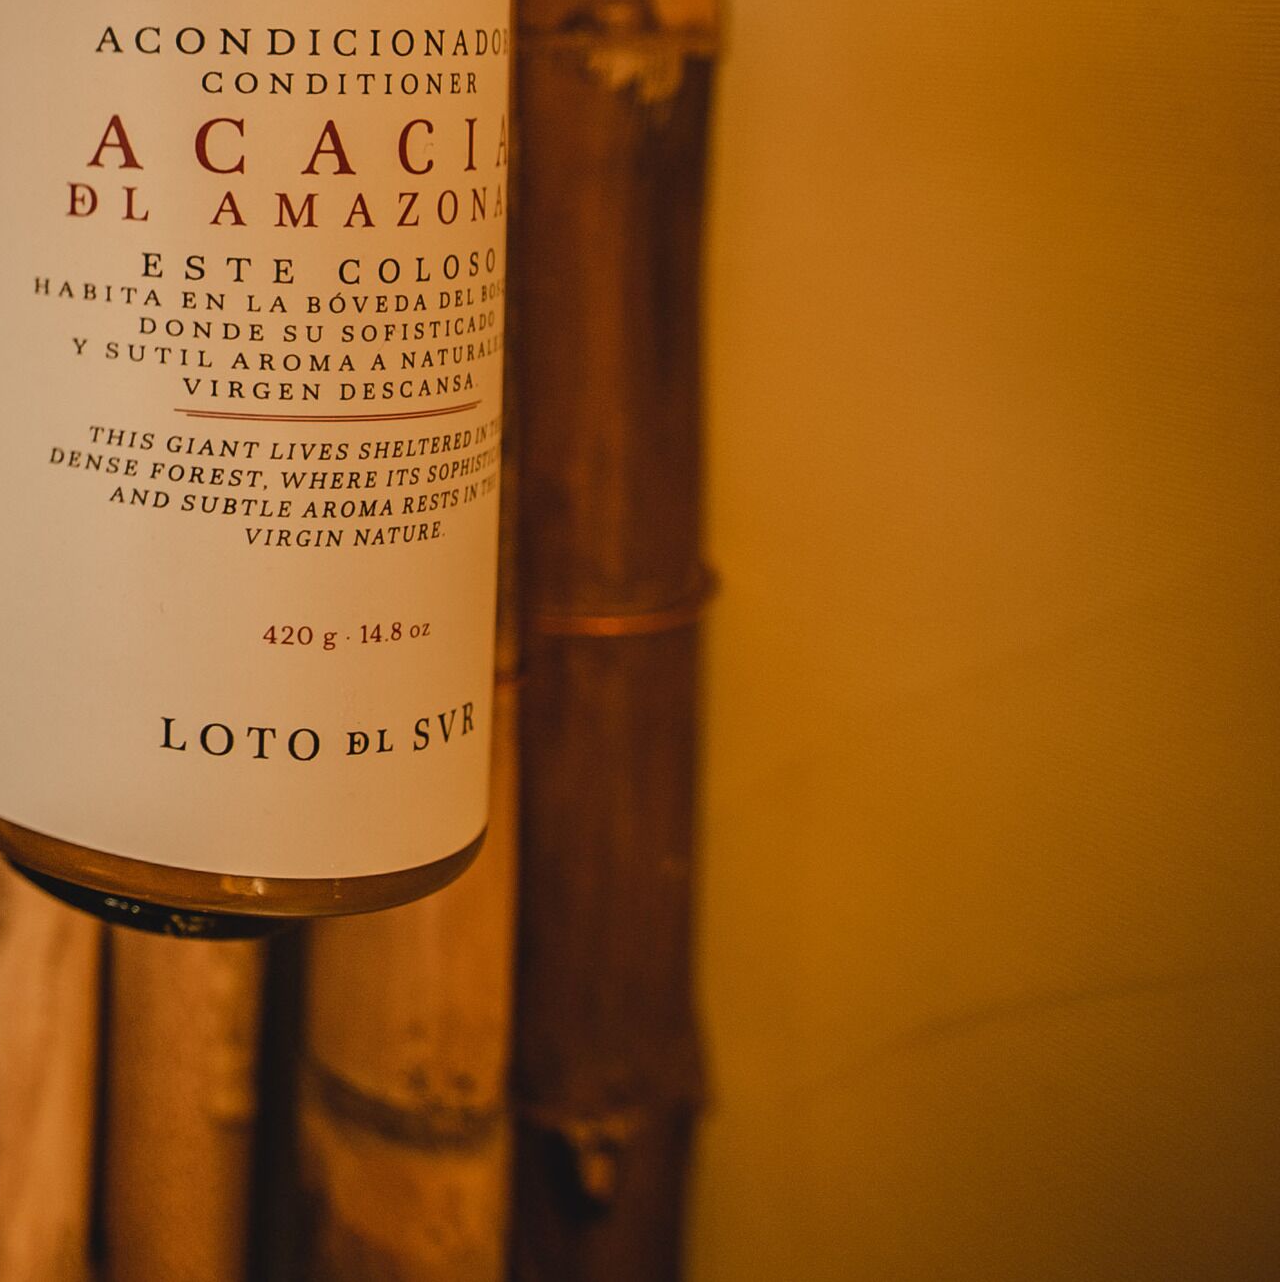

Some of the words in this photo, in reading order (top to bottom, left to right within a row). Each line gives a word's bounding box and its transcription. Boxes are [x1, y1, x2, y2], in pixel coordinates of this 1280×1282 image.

[201, 70, 478, 96] CONDITIONER
[86, 113, 507, 176] ACACIA
[208, 184, 503, 229] AMAZONA
[141, 251, 295, 285] ESTE
[338, 247, 496, 286] COLOSO
[34, 276, 162, 308] HABITA
[181, 290, 226, 311] EN
[246, 294, 288, 314] LA
[305, 291, 428, 315] BÓVEDA
[438, 287, 475, 310] DEL
[138, 316, 265, 342] DONDE
[282, 324, 324, 344] SU
[340, 310, 496, 343] SOFISTICADO
[72, 337, 88, 356] Y
[105, 341, 213, 369] SUTIL
[230, 351, 356, 373] AROMA
[369, 352, 387, 372] A
[182, 376, 321, 401] VIRGEN
[89, 425, 156, 451] THIS
[166, 435, 261, 459] GIANT
[269, 442, 350, 462] LIVES
[357, 429, 472, 461] SHELTERED
[474, 425, 487, 445] IN
[49, 446, 139, 477] DENSE
[149, 461, 268, 492] FOREST,
[280, 470, 378, 490] WHERE
[385, 466, 421, 488] ITS
[108, 485, 170, 509] AND
[180, 493, 293, 519] SUBTLE
[300, 498, 394, 519] AROMA
[400, 488, 460, 515] RESTS
[463, 482, 479, 504] IN
[244, 527, 345, 548] VIRGIN
[262, 624, 314, 646] 420
[322, 631, 339, 652] g
[360, 621, 403, 645] 14.8
[409, 622, 431, 639] oz
[159, 716, 321, 762] LOTO
[412, 701, 475, 753] SVR
